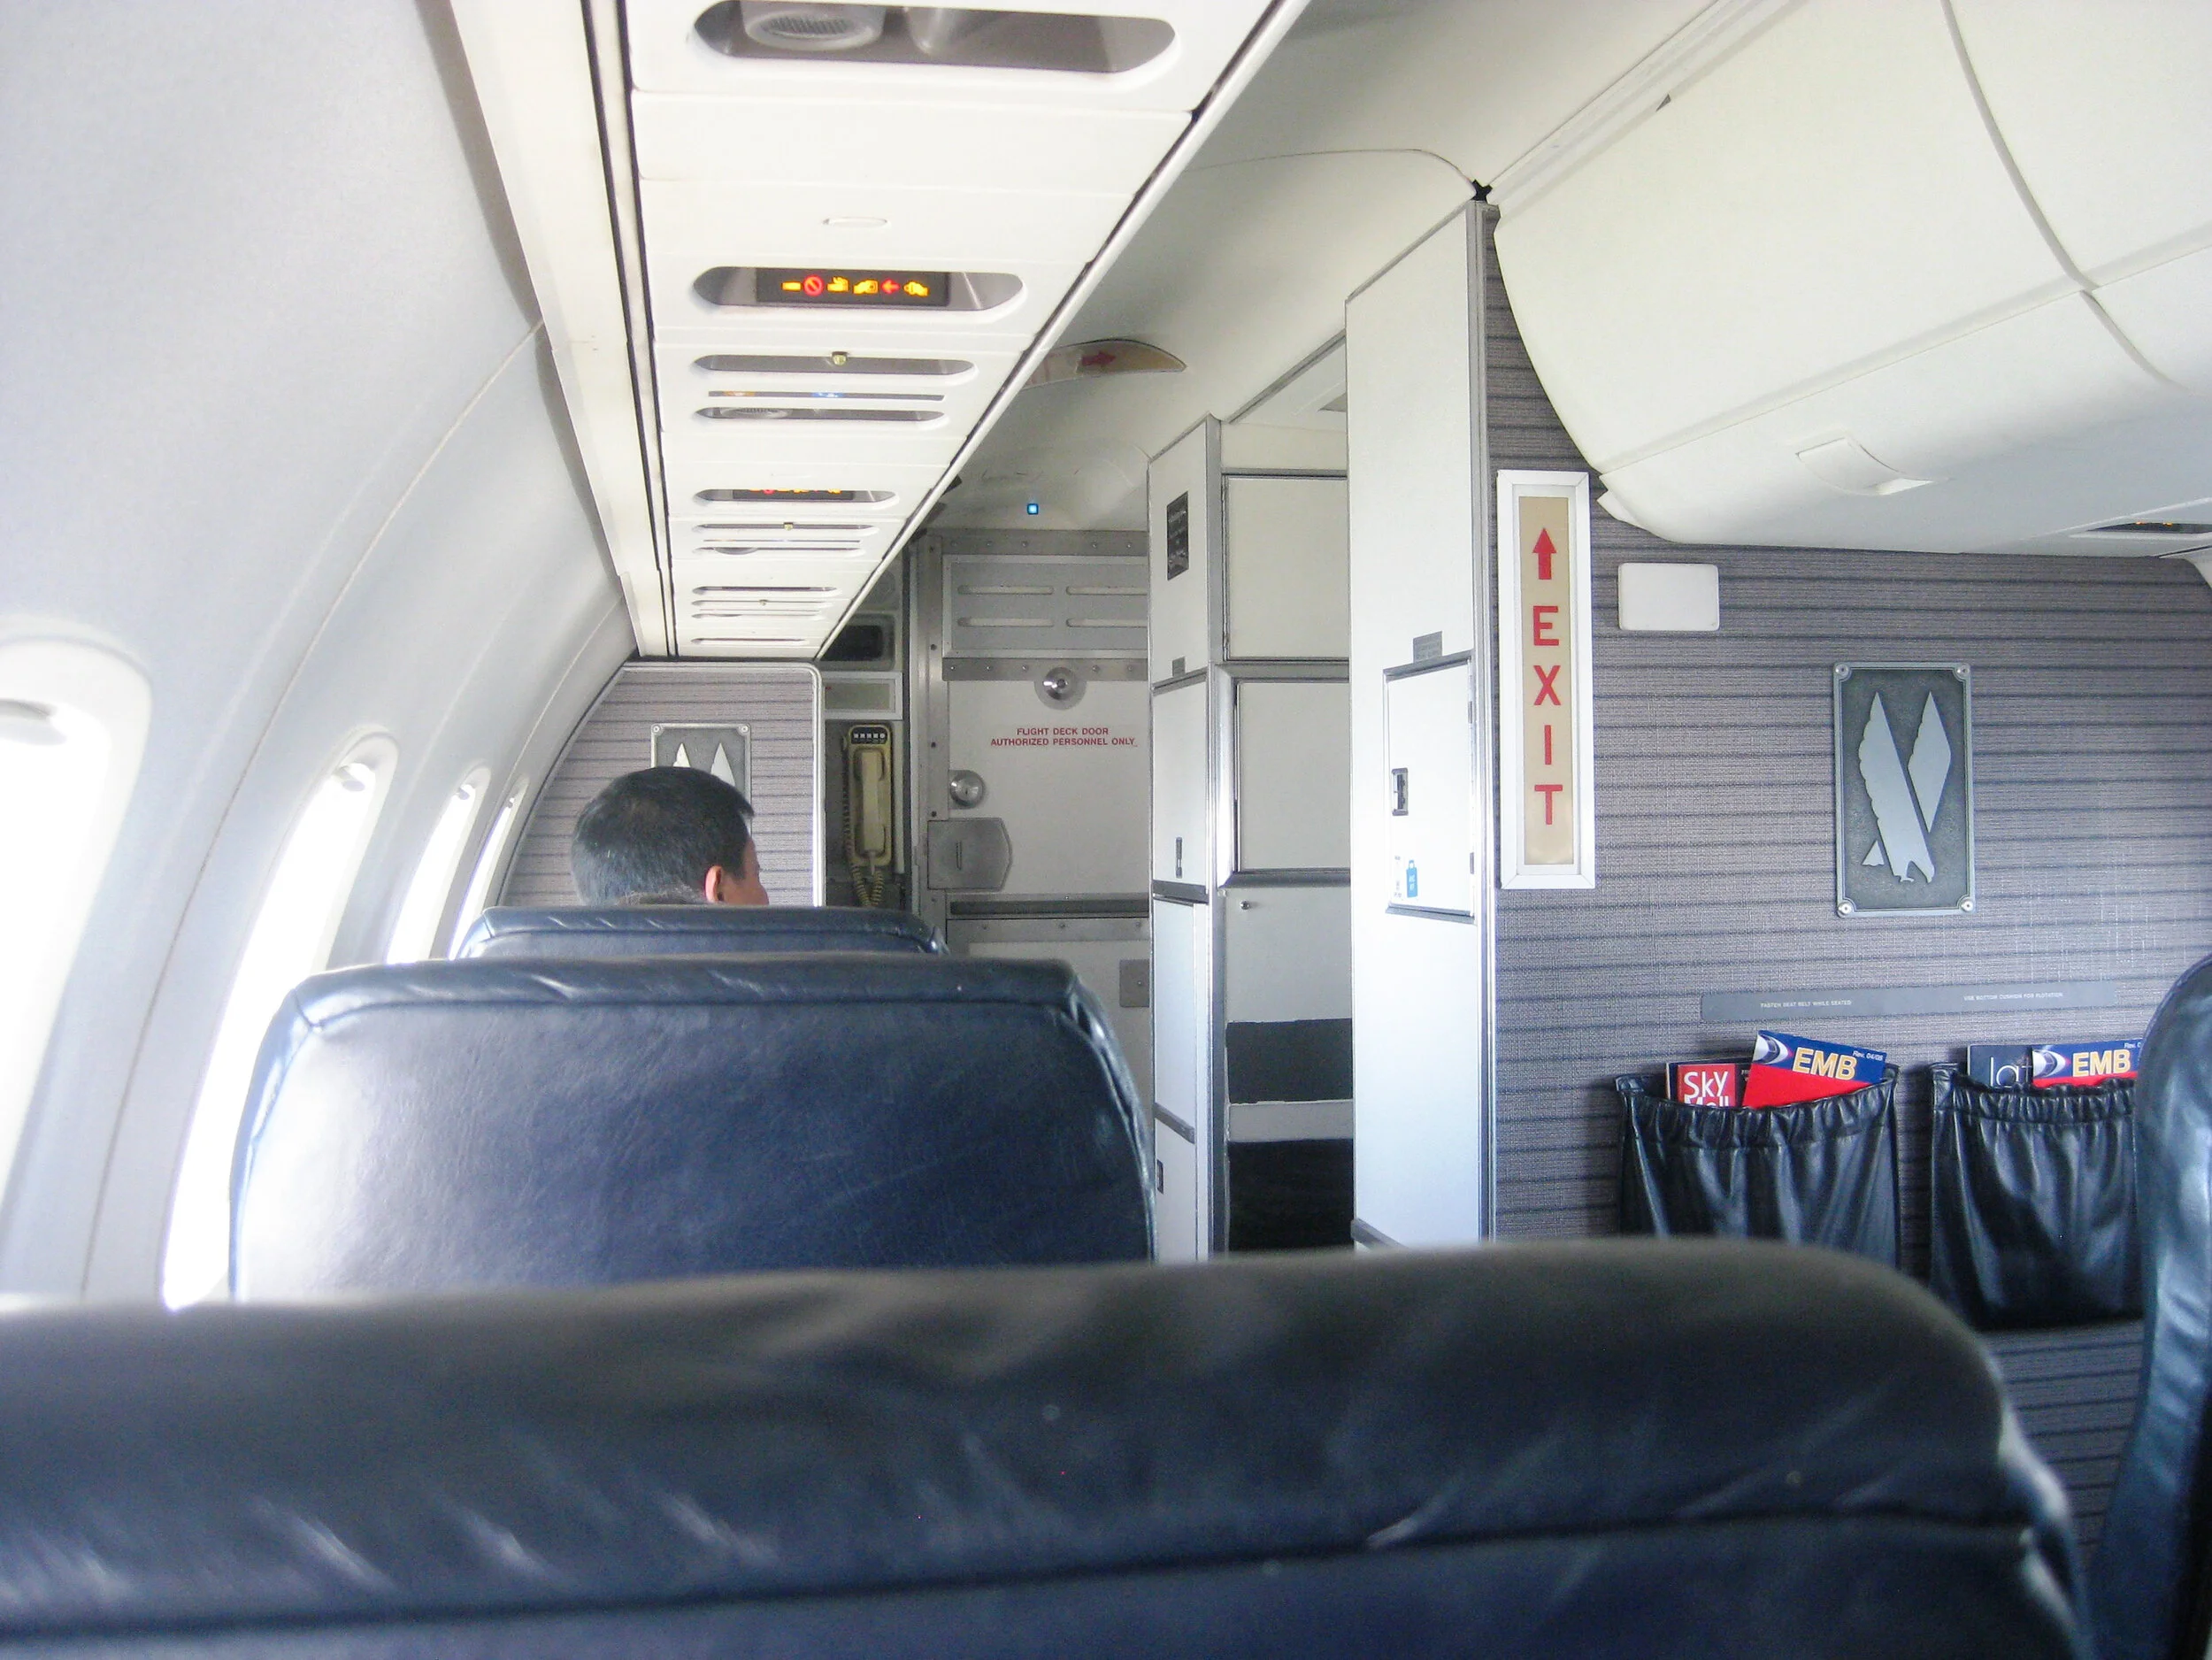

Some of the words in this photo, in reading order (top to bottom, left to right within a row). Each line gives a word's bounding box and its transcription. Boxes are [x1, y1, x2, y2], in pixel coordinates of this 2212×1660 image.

[1532, 605, 1563, 826] EXIT
[1792, 1047, 1858, 1080] EMB
[2072, 1049, 2131, 1077] EMB
